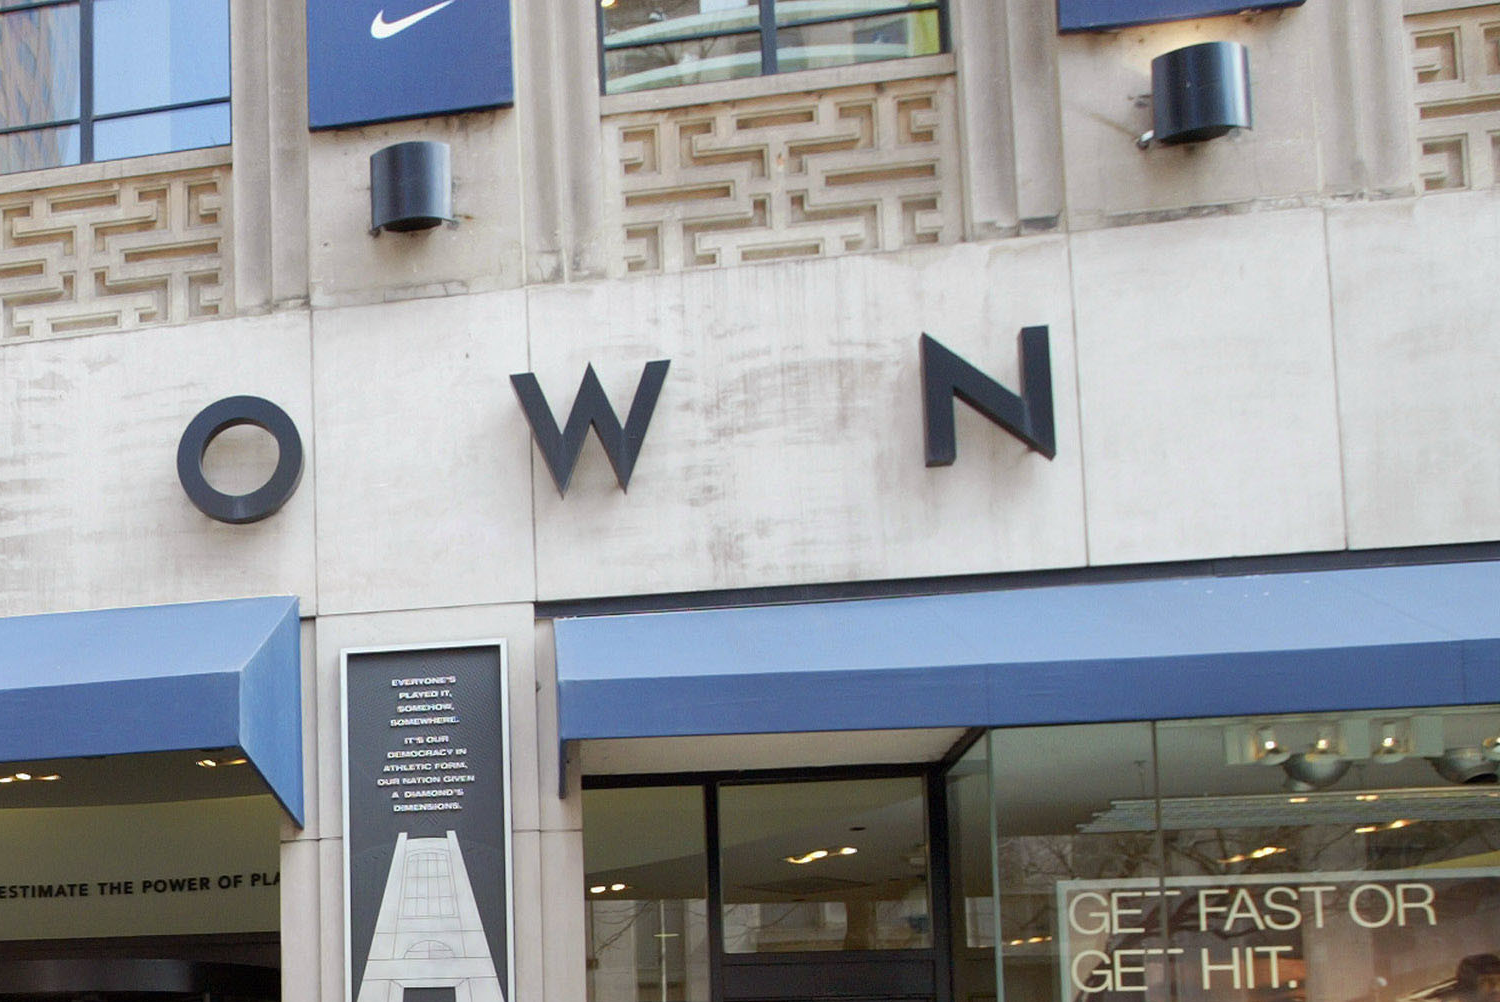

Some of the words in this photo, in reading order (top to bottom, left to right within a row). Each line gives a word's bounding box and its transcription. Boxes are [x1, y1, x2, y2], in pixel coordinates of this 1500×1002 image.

[391, 676, 457, 687] EVERYONE'S
[398, 690, 439, 699] PLAYED
[404, 736, 425, 745] IT'S
[426, 735, 449, 744] OUR
[387, 748, 454, 759] DEMOCRACY
[455, 747, 468, 756] IN
[383, 762, 432, 772] ATHLETIC
[377, 777, 400, 787] OUR
[402, 776, 441, 786] NATION
[442, 774, 476, 784] GIVEN
[391, 791, 400, 799] A
[404, 788, 465, 799] DIAMOND'S
[97, 881, 134, 896] THE
[142, 877, 210, 894] POWER
[218, 874, 243, 890] OF
[1068, 891, 1183, 935] GET
[1200, 886, 1336, 932] FAST
[1348, 883, 1437, 929] OR
[1070, 948, 1184, 993] GET
[1201, 945, 1299, 991] HIT.
